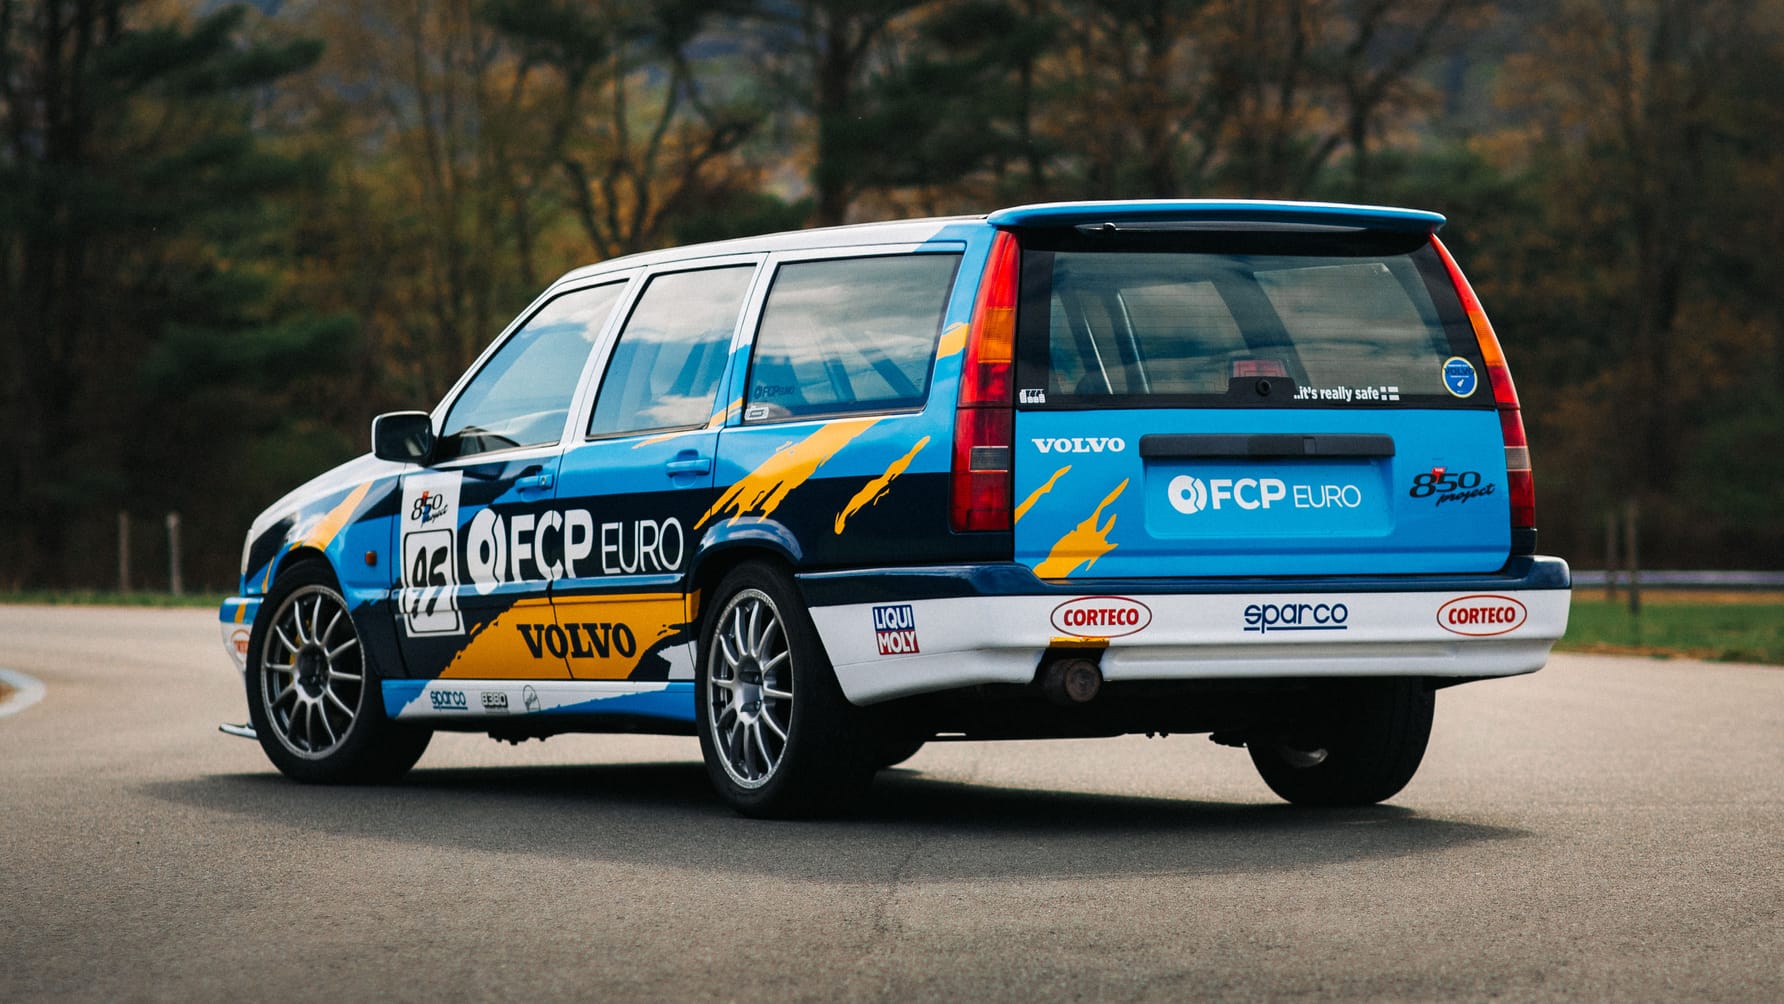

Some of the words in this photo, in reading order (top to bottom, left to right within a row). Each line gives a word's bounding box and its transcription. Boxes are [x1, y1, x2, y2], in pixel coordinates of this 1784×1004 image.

[1320, 386, 1352, 402] really
[1355, 386, 1379, 400] safe
[1032, 437, 1125, 453] VOLVO
[1211, 478, 1286, 510] FCP
[1294, 485, 1362, 508] EURO
[1409, 471, 1481, 498] 850
[1436, 482, 1496, 507] project
[411, 493, 443, 521] 850
[510, 508, 594, 583] FCP
[601, 516, 685, 575] EURO
[411, 545, 449, 619] 95
[874, 606, 913, 630] LIQUI
[1063, 608, 1140, 627] CORTECO
[1243, 603, 1349, 634] sparco
[1448, 607, 1516, 625] CORTECO
[516, 622, 637, 659] VOLVO
[877, 631, 916, 654] MOLY
[430, 690, 468, 712] sparco
